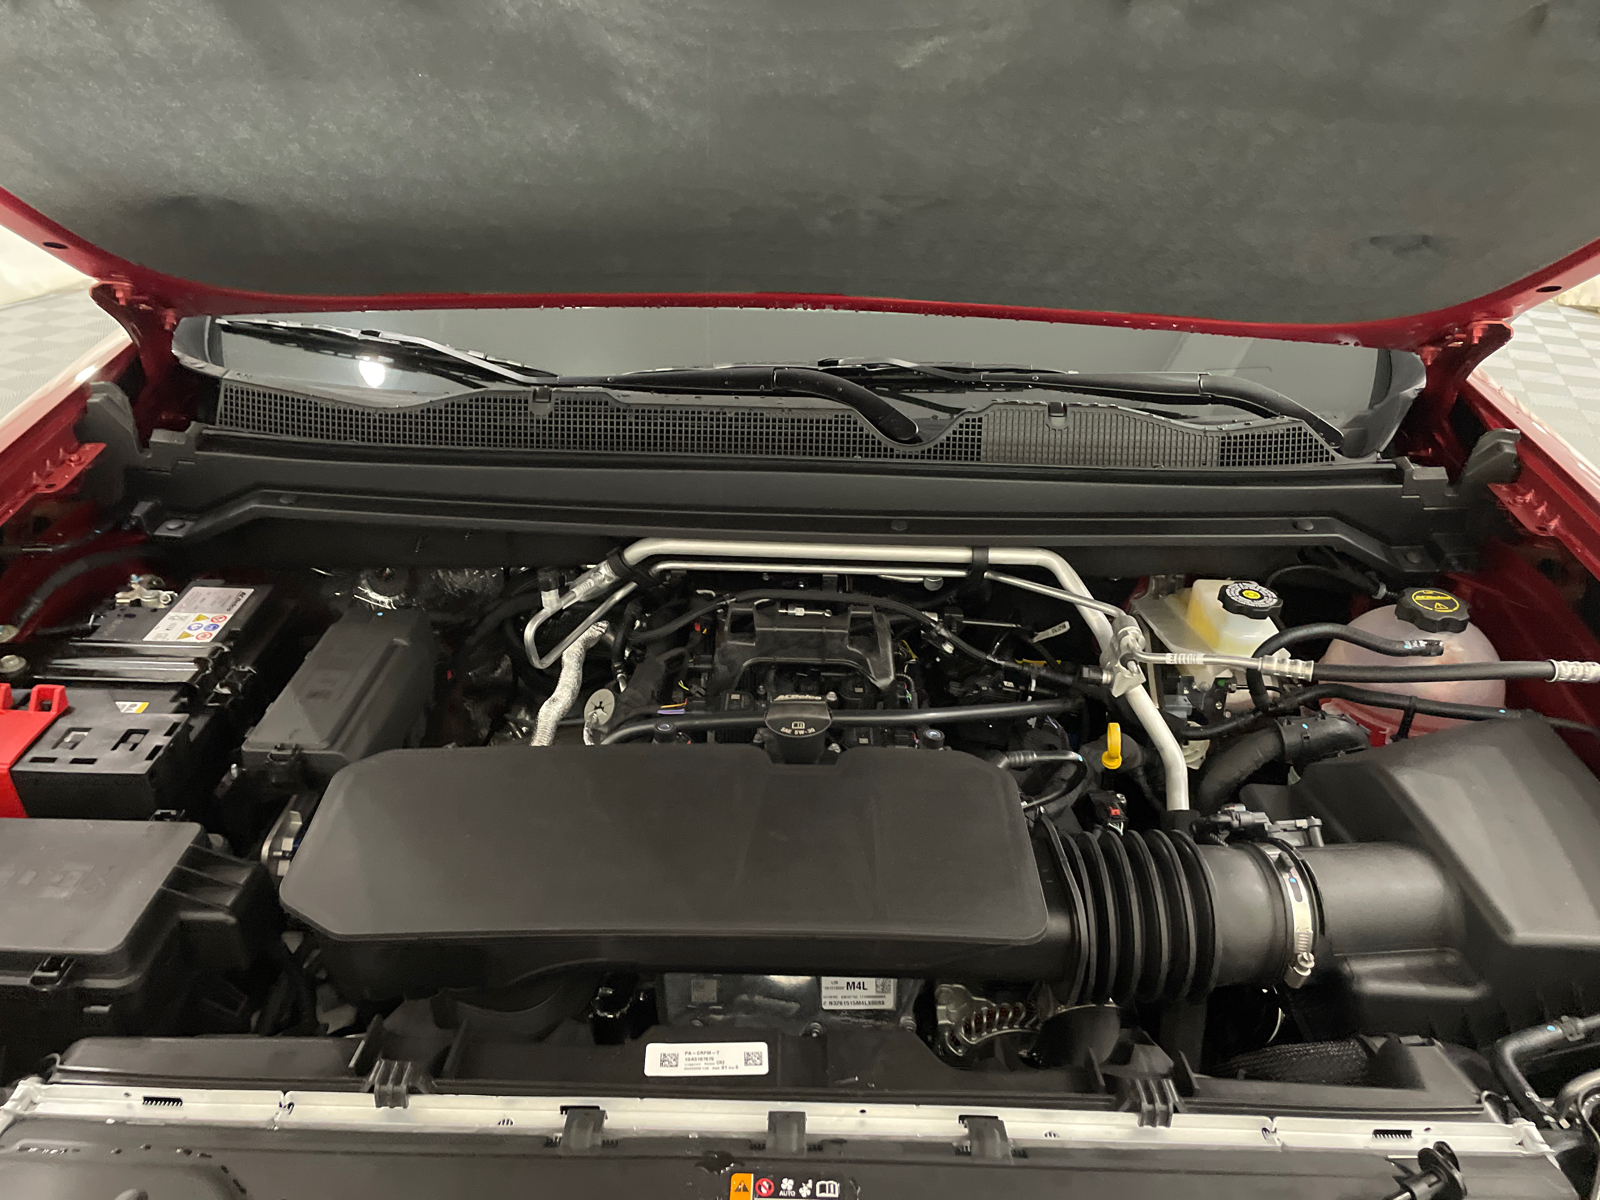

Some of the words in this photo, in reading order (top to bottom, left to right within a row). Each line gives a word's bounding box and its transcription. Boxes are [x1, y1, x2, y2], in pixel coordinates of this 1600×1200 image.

[780, 726, 792, 734] SAE
[794, 727, 816, 735] 5W-30
[846, 981, 868, 991] M4L
